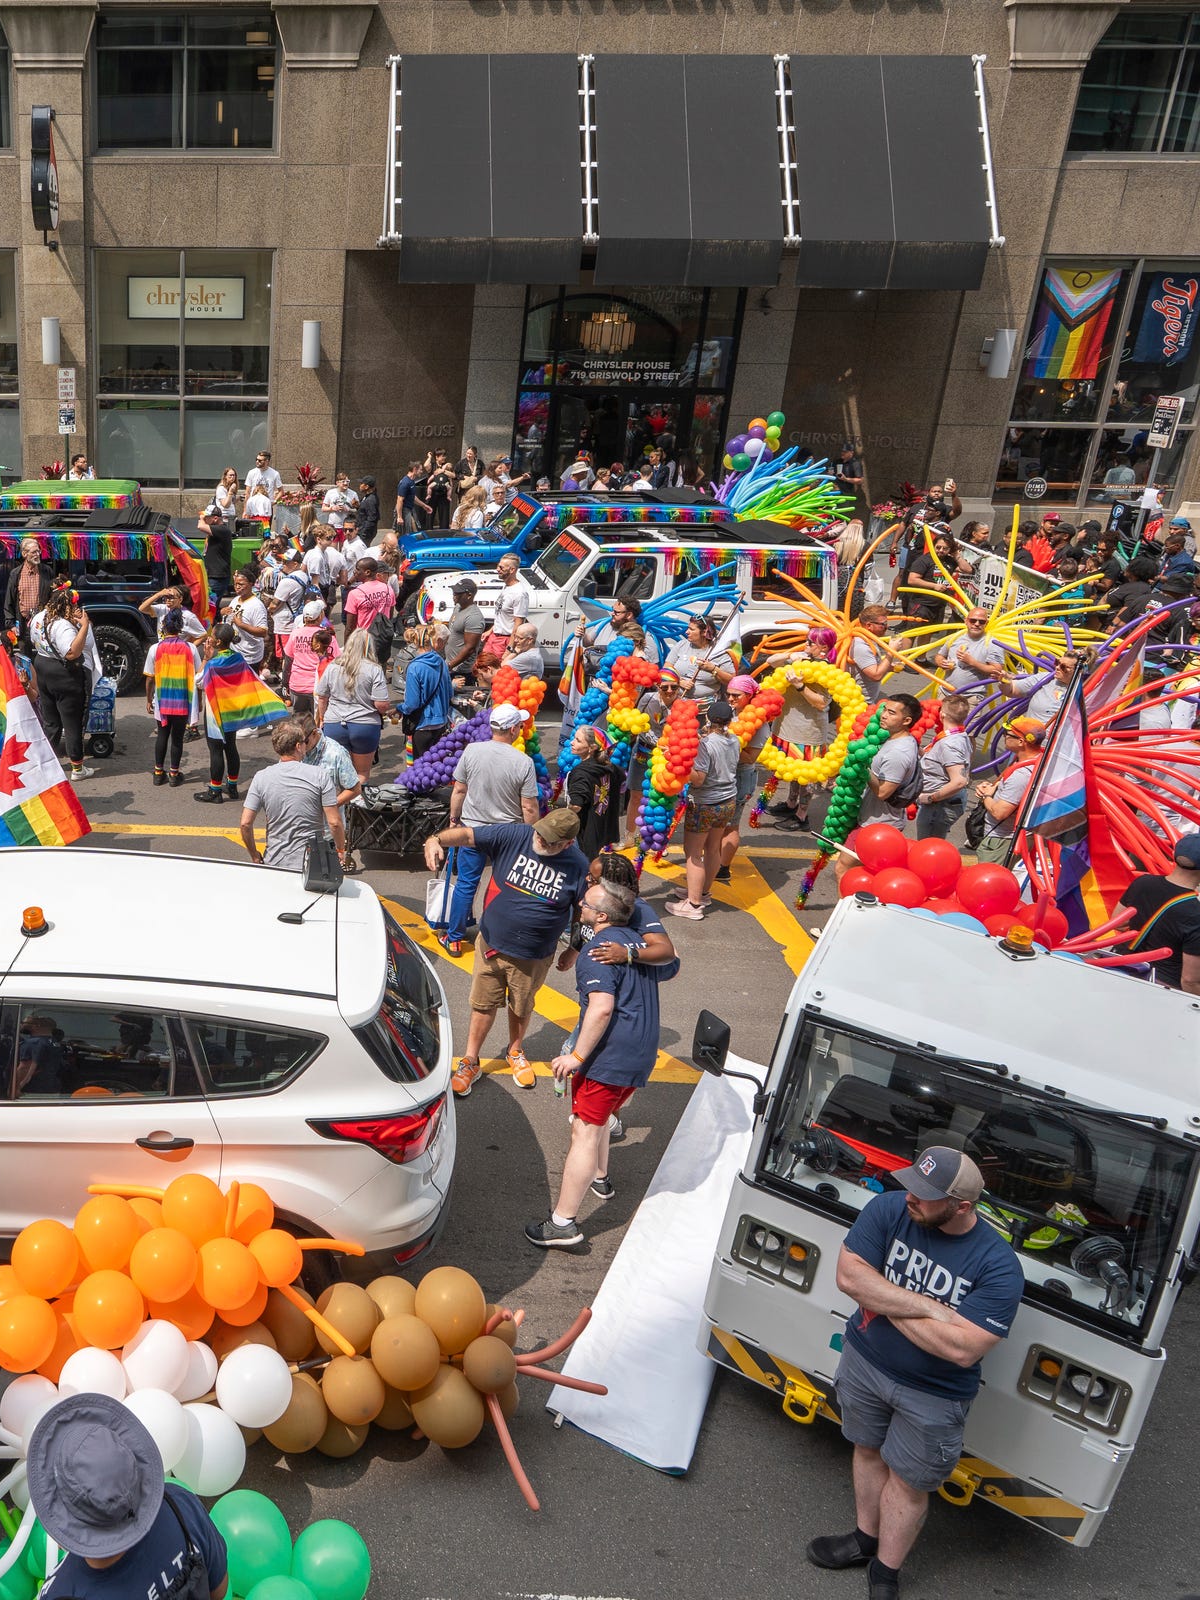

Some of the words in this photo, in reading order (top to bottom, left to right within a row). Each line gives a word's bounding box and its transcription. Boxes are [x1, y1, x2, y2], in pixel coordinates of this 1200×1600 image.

[1152, 278, 1198, 357] Tigers
[1177, 312, 1192, 347] DETROIT
[570, 372, 586, 380] 719
[588, 372, 641, 380] GRISWOLD
[643, 372, 680, 380] STREET
[584, 360, 635, 369] CHRYSLER
[636, 362, 670, 370] HOUSE
[352, 428, 410, 440] CHRYSLER
[414, 425, 455, 438] HOUSE
[984, 573, 1011, 588] JUL
[506, 870, 519, 883] IN
[520, 875, 559, 901] FLIGHT.
[511, 854, 568, 889] PRIDE
[885, 1238, 974, 1306] PRIDE
